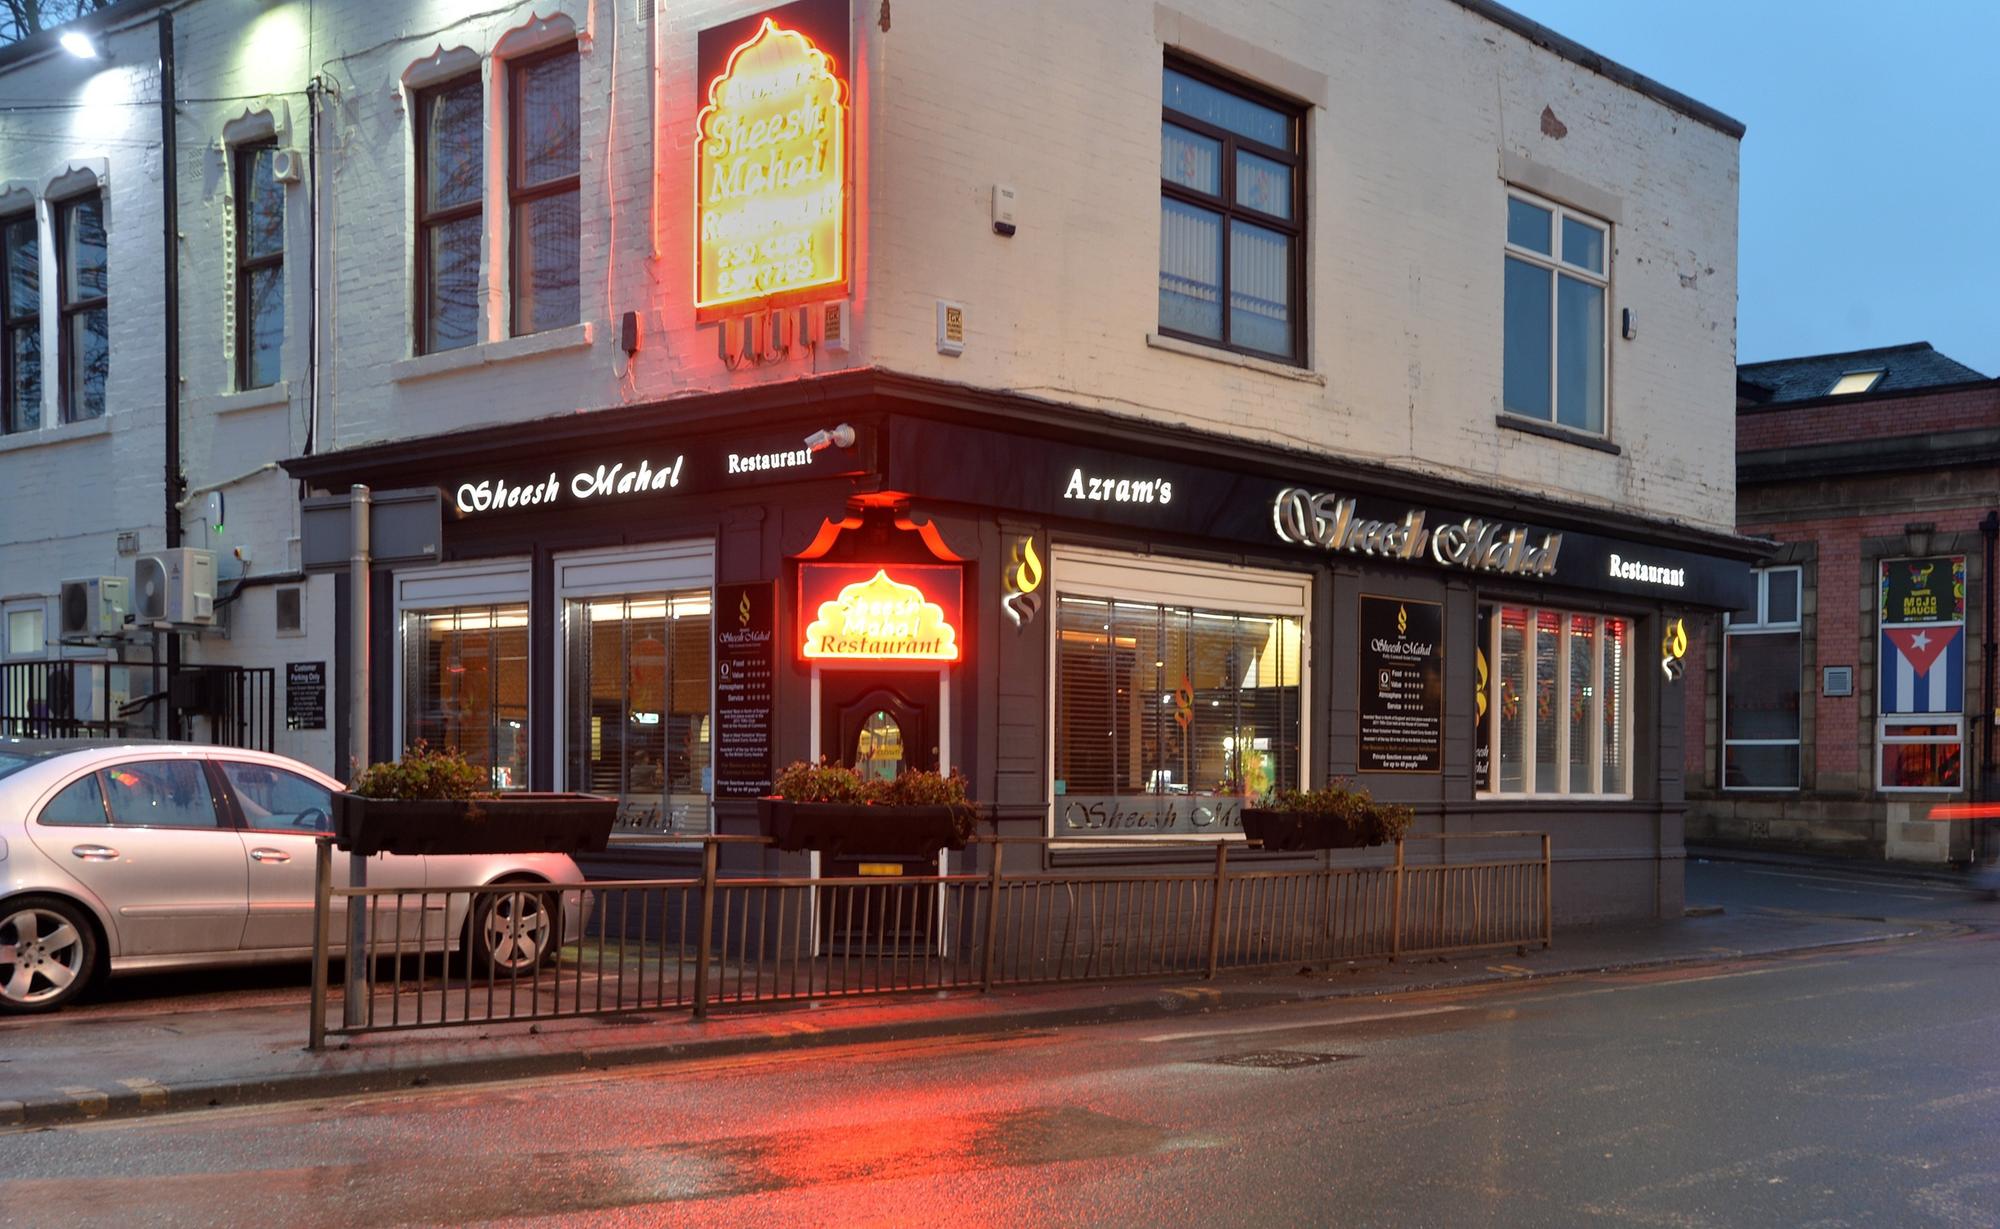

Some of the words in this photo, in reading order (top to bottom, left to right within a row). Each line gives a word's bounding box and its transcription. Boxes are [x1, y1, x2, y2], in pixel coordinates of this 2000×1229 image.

[710, 94, 824, 155] Sheesh
[710, 141, 822, 201] Mahal
[729, 448, 813, 474] Restaurant
[457, 473, 560, 513] Sheesh
[571, 455, 683, 498] Mahal
[1064, 468, 1171, 504] Azram's
[1273, 487, 1429, 559] Sheesh
[1432, 516, 1563, 578] Mahal
[1610, 554, 1685, 587] Restaurant
[841, 594, 920, 616] Sheesh
[1904, 596, 1937, 608] MOJO
[1904, 606, 1937, 616] SAUCE
[842, 615, 920, 637] Mahal
[821, 635, 941, 654] Restaurant
[1371, 638, 1401, 653] Sheesh
[1402, 641, 1432, 656] Mahal
[1065, 801, 1177, 829] Sheesh
